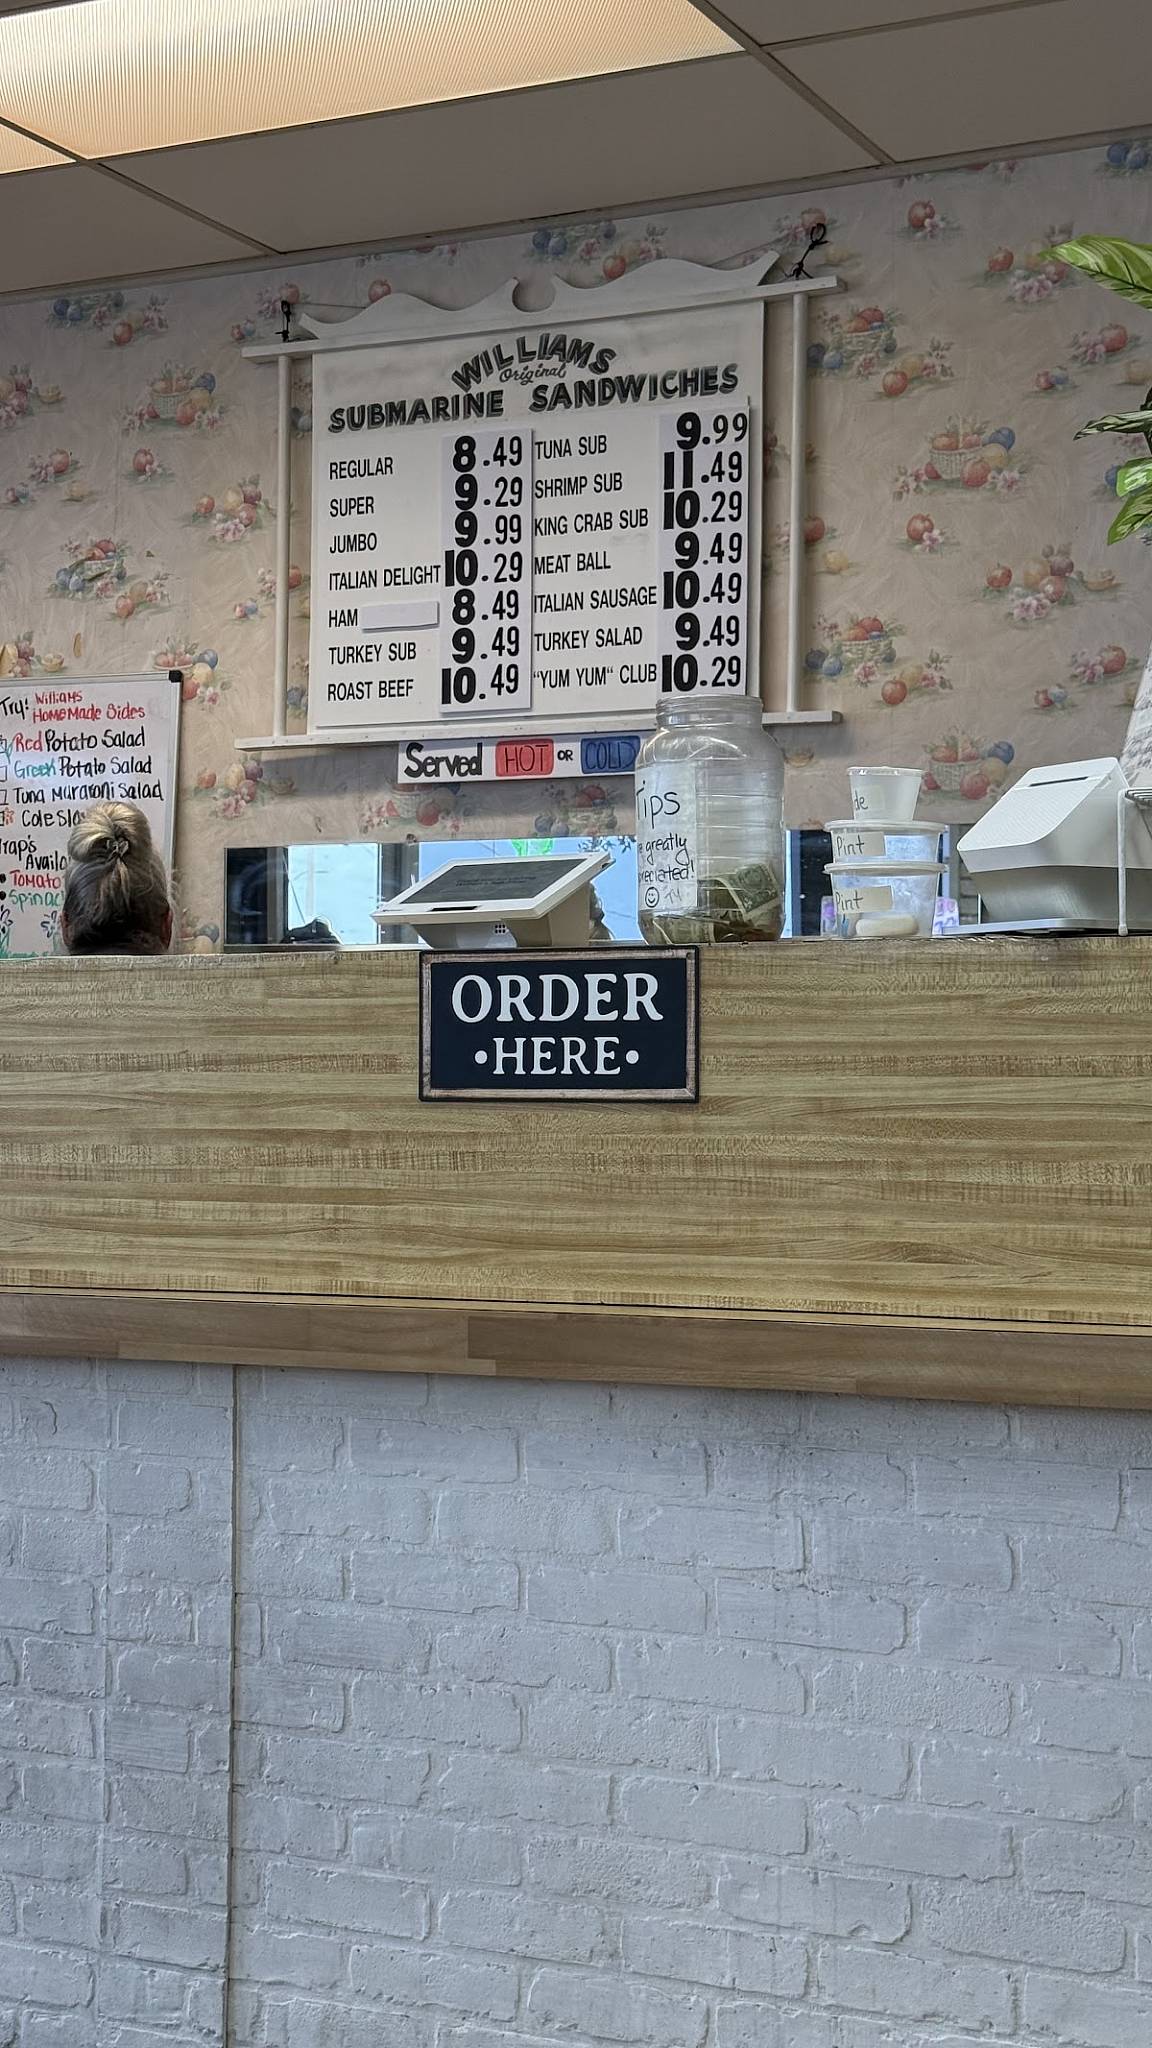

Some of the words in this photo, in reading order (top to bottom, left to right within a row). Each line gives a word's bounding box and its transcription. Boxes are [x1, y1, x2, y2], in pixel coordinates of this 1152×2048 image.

[452, 333, 616, 392] WILLIAMS
[500, 362, 566, 385] Original
[328, 389, 504, 433] SUBMARINE
[529, 363, 739, 412] SANDWICHES
[535, 439, 572, 459] TUNA
[578, 435, 607, 455] SUB
[676, 412, 748, 449] 9.99
[330, 457, 393, 480] REGULAR
[453, 436, 522, 472] 8.49
[534, 476, 587, 498] SHRIMP
[594, 472, 622, 493] SUB
[664, 451, 742, 490] 11.49
[330, 496, 374, 517] SUPER
[455, 474, 522, 510] 9.29
[534, 516, 568, 536] KING
[574, 512, 612, 532] CRAB
[619, 508, 648, 529] SUB
[663, 490, 742, 530] 10.29
[330, 533, 377, 553] JUMBO
[455, 511, 522, 547] 9.99
[329, 570, 377, 590] ITALIAN
[384, 565, 440, 586] DELIGHT
[445, 549, 522, 586] 10.29
[534, 555, 570, 574] MEAT
[577, 551, 611, 571] BALL
[675, 531, 742, 569] 9.49
[329, 609, 358, 628] HAM
[452, 589, 519, 625] 8.49
[534, 592, 583, 613] ITALIAN
[590, 586, 657, 609] SAUSAGE
[663, 571, 742, 609] 10.49
[329, 644, 382, 664] TURKEY
[389, 642, 416, 661] SUB
[452, 626, 519, 664] 9.49
[534, 630, 589, 651] TURKEY
[595, 627, 642, 647] SALAD
[675, 613, 740, 650] 9.49
[328, 682, 372, 701] ROAST
[378, 679, 413, 698] BEEF
[442, 664, 519, 704] 10.49
[620, 664, 657, 684] CLUB
[662, 654, 741, 692] 10.29
[107, 702, 145, 719] Sides
[16, 730, 42, 752] Red
[45, 729, 97, 752] Potato
[102, 726, 145, 748] Salad
[59, 756, 105, 777] Potato
[111, 755, 152, 774] Salad
[404, 742, 483, 778] Served
[505, 745, 548, 773] HOT
[558, 749, 573, 761] OR
[585, 741, 637, 770] COLD
[13, 787, 45, 804] Tuna
[118, 779, 164, 801] Salad
[636, 780, 680, 829] Tips
[22, 810, 54, 827] Cole
[58, 808, 85, 828] Sla
[0, 835, 37, 861] rap's
[646, 833, 690, 866] greatly
[836, 835, 864, 856] Pint
[640, 860, 694, 882] reciated!
[836, 890, 863, 912] Pint
[452, 973, 664, 1023] ORDER
[493, 1037, 620, 1074] HERE
